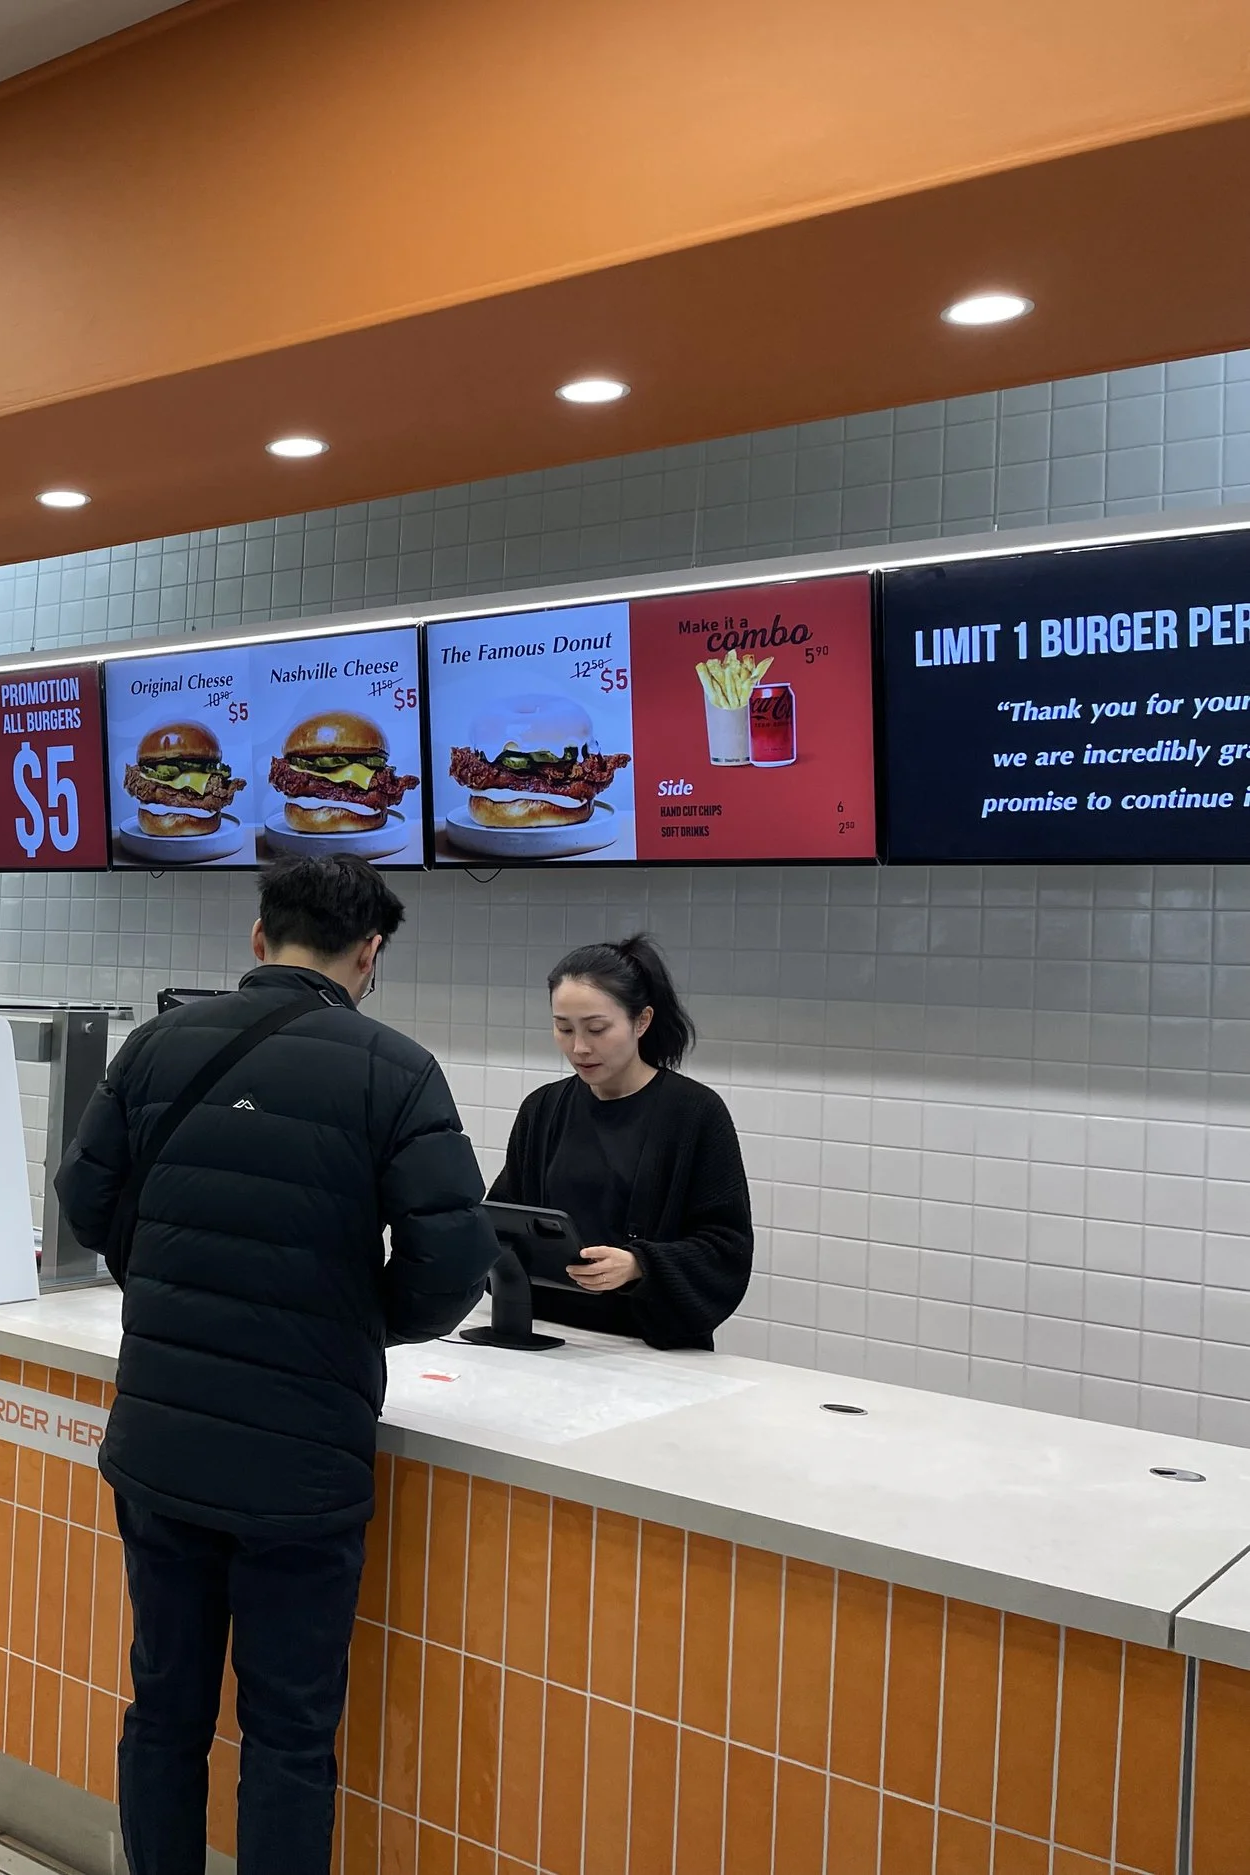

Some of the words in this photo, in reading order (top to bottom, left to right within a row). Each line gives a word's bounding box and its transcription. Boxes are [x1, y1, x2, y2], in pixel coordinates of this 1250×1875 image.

[679, 618, 719, 634] Make
[724, 616, 734, 630] it
[740, 618, 749, 628] a
[707, 614, 814, 652] combo
[915, 623, 1001, 667] LIMIT
[1013, 621, 1028, 660] 1
[1040, 609, 1178, 658] BURGER
[1188, 602, 1250, 648] PER
[441, 646, 471, 665] The
[478, 642, 545, 661] Famous
[553, 632, 613, 654] Donut
[270, 662, 337, 684] Nashville
[344, 659, 399, 677] Cheese
[600, 667, 628, 693] $5
[1, 677, 80, 707] PROMOTION
[131, 676, 183, 698] Original
[188, 673, 233, 691] Chesse
[394, 687, 418, 711] $5
[3, 713, 25, 734] ALL
[26, 707, 82, 732] BURGERS
[228, 701, 249, 724] $5
[1090, 700, 1137, 724] you
[1146, 693, 1184, 715] for
[1192, 695, 1250, 719] your
[993, 752, 1027, 767] we
[1035, 750, 1074, 767] are
[1083, 738, 1211, 767] incredibly
[13, 741, 80, 858] $5
[657, 778, 694, 797] Side
[660, 805, 682, 817] HAND
[682, 805, 698, 817] CUT
[699, 804, 723, 816] CHIPS
[837, 800, 844, 813] 6
[981, 790, 1078, 818] promise
[1087, 792, 1112, 811] to
[1121, 787, 1234, 809] continue
[661, 826, 680, 838] SOFT
[680, 825, 710, 837] DRINKS
[56, 1415, 106, 1448] HER
